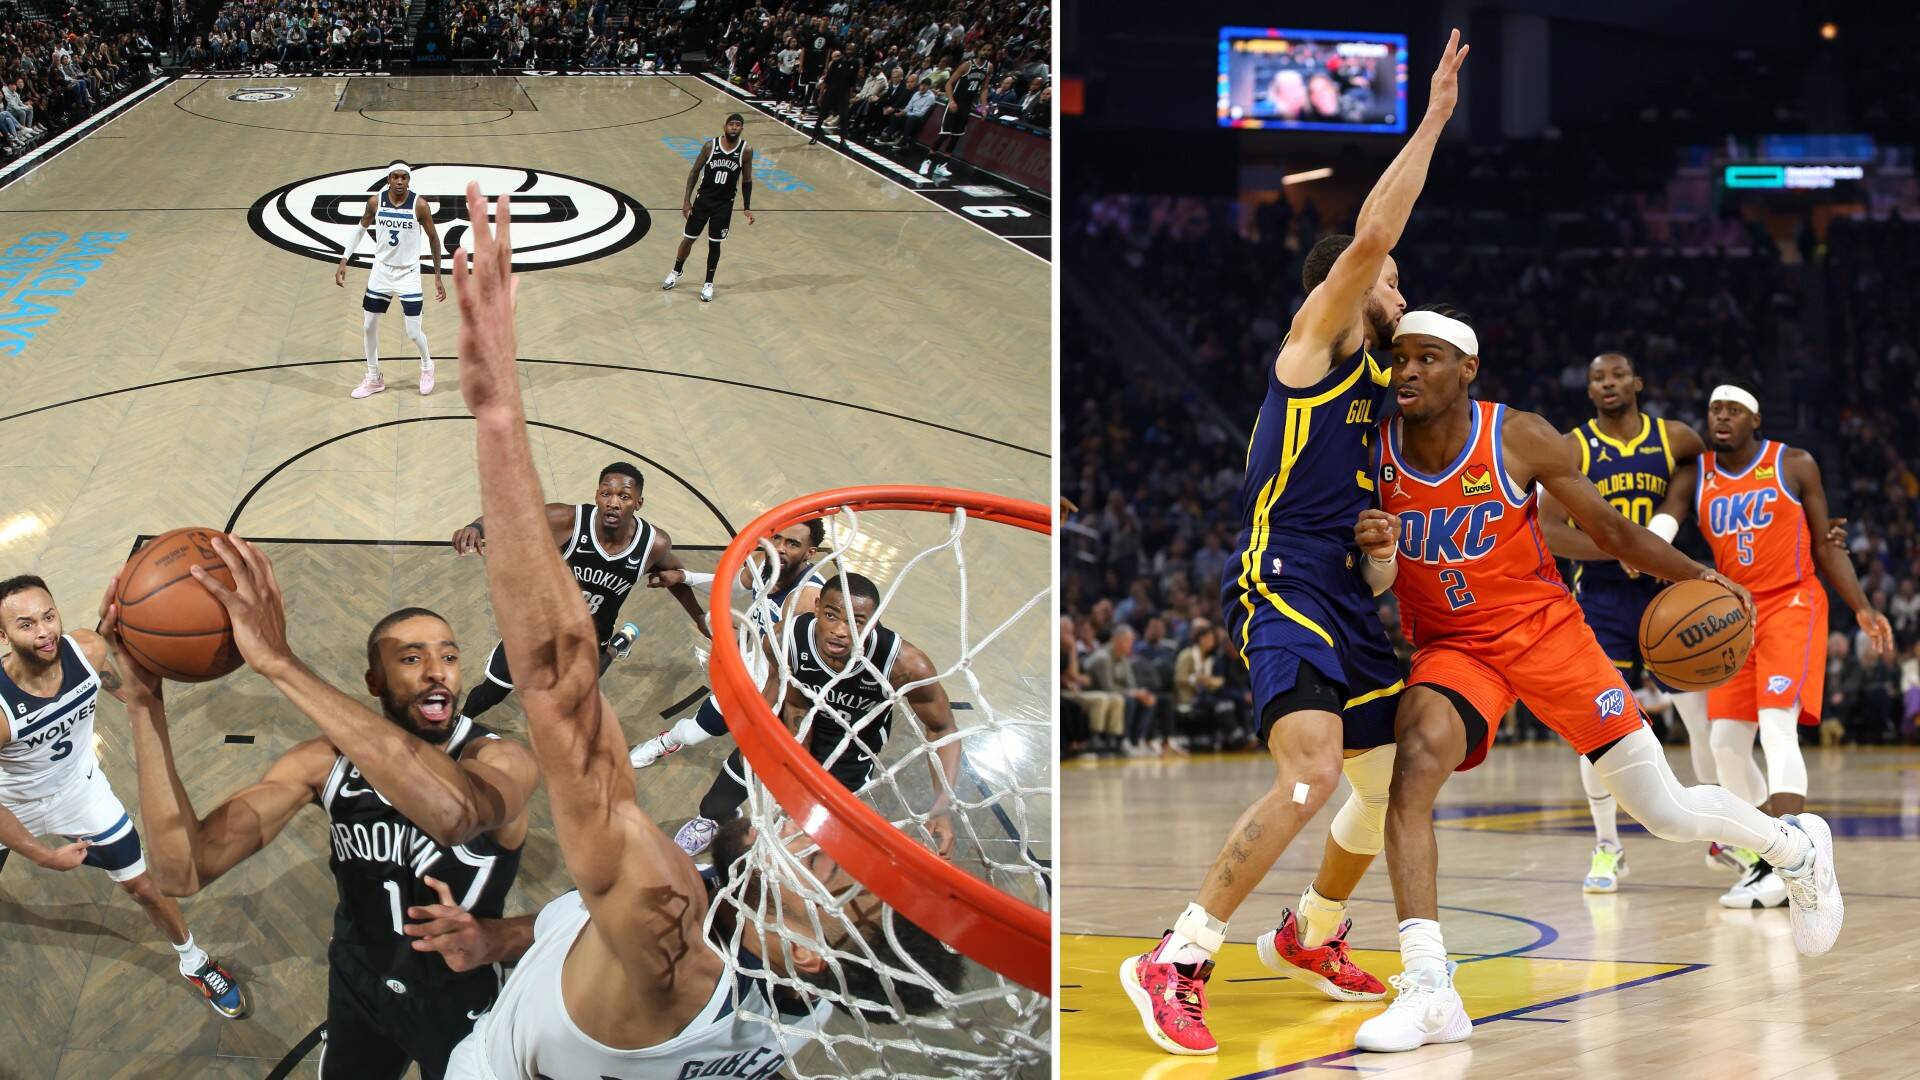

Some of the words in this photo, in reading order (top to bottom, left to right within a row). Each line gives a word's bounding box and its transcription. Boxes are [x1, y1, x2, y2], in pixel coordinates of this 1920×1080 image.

[709, 159, 740, 172] BROOKLYN
[714, 171, 728, 185] 00
[378, 219, 413, 230] WOLVES
[388, 230, 400, 247] 3
[1383, 466, 1394, 481] 6
[1463, 481, 1491, 494] Love's
[1709, 486, 1778, 538] OKC
[580, 534, 589, 544] 6
[1397, 500, 1504, 565] OKC
[1737, 531, 1754, 566] 5
[573, 566, 633, 596] ROOKLYN
[1440, 569, 1476, 611] 2
[1676, 607, 1745, 649] Wilson
[16, 702, 28, 715] 6
[23, 699, 96, 749] WOLVES
[49, 730, 73, 762] 5
[330, 821, 443, 879] BROOKYN
[383, 879, 405, 936] 1
